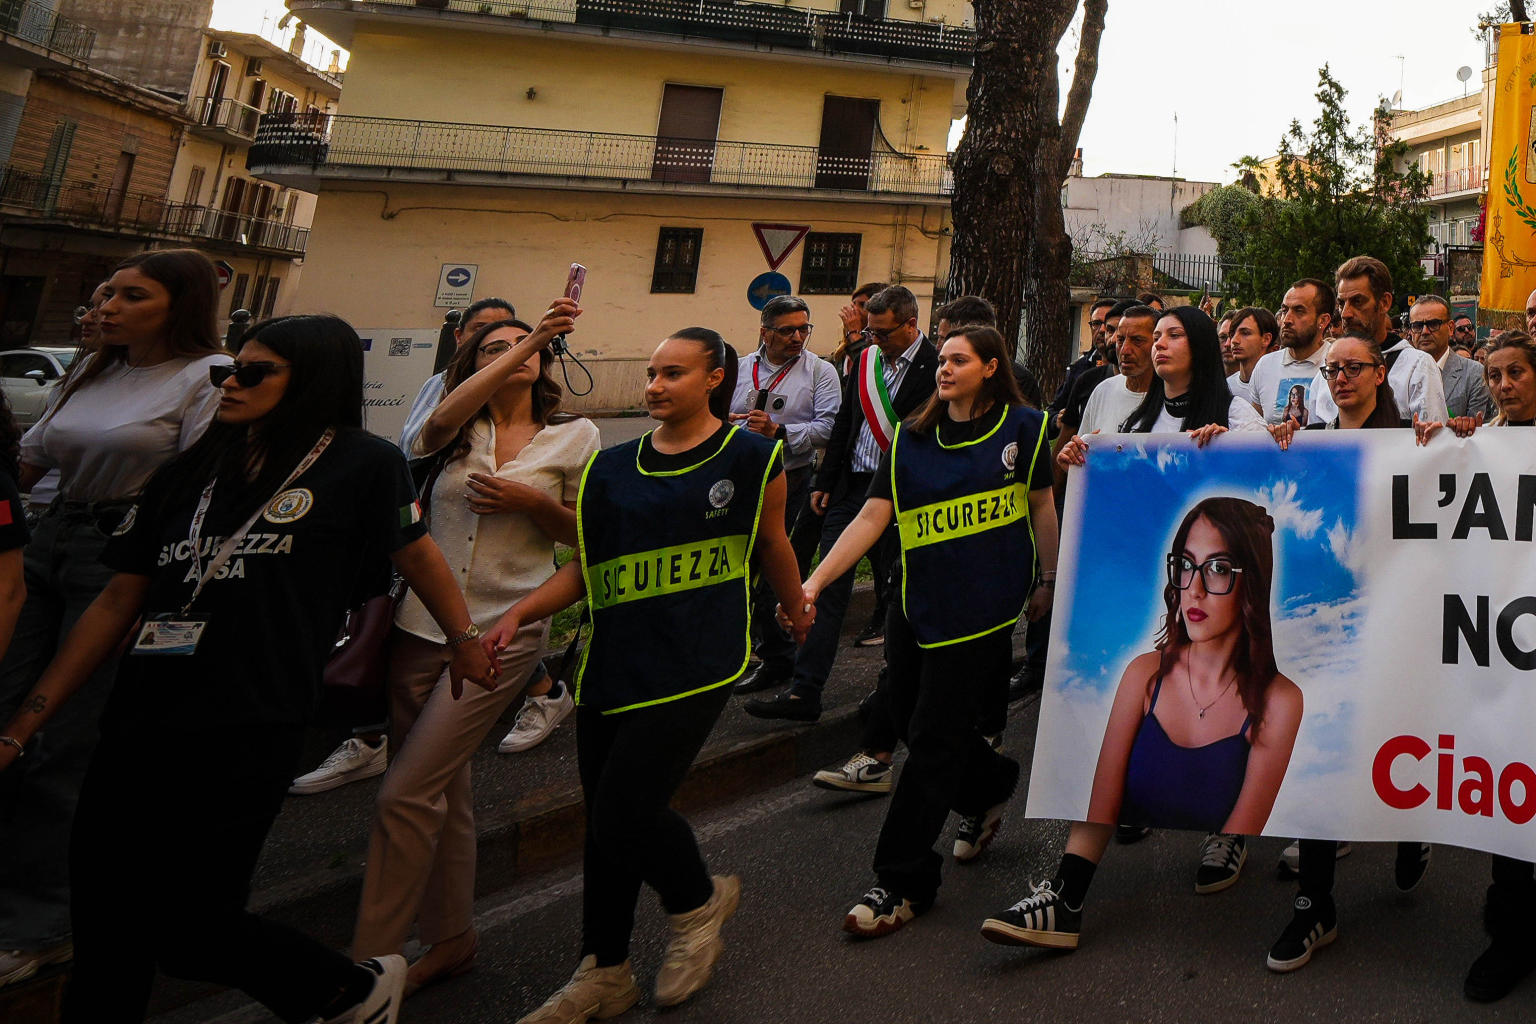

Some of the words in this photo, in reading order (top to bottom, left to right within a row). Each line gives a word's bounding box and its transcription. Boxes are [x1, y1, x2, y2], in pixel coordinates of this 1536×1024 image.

[916, 491, 1018, 539] SICUREZZA
[183, 557, 245, 583] ASA
[603, 544, 731, 601] SICUREZZA
